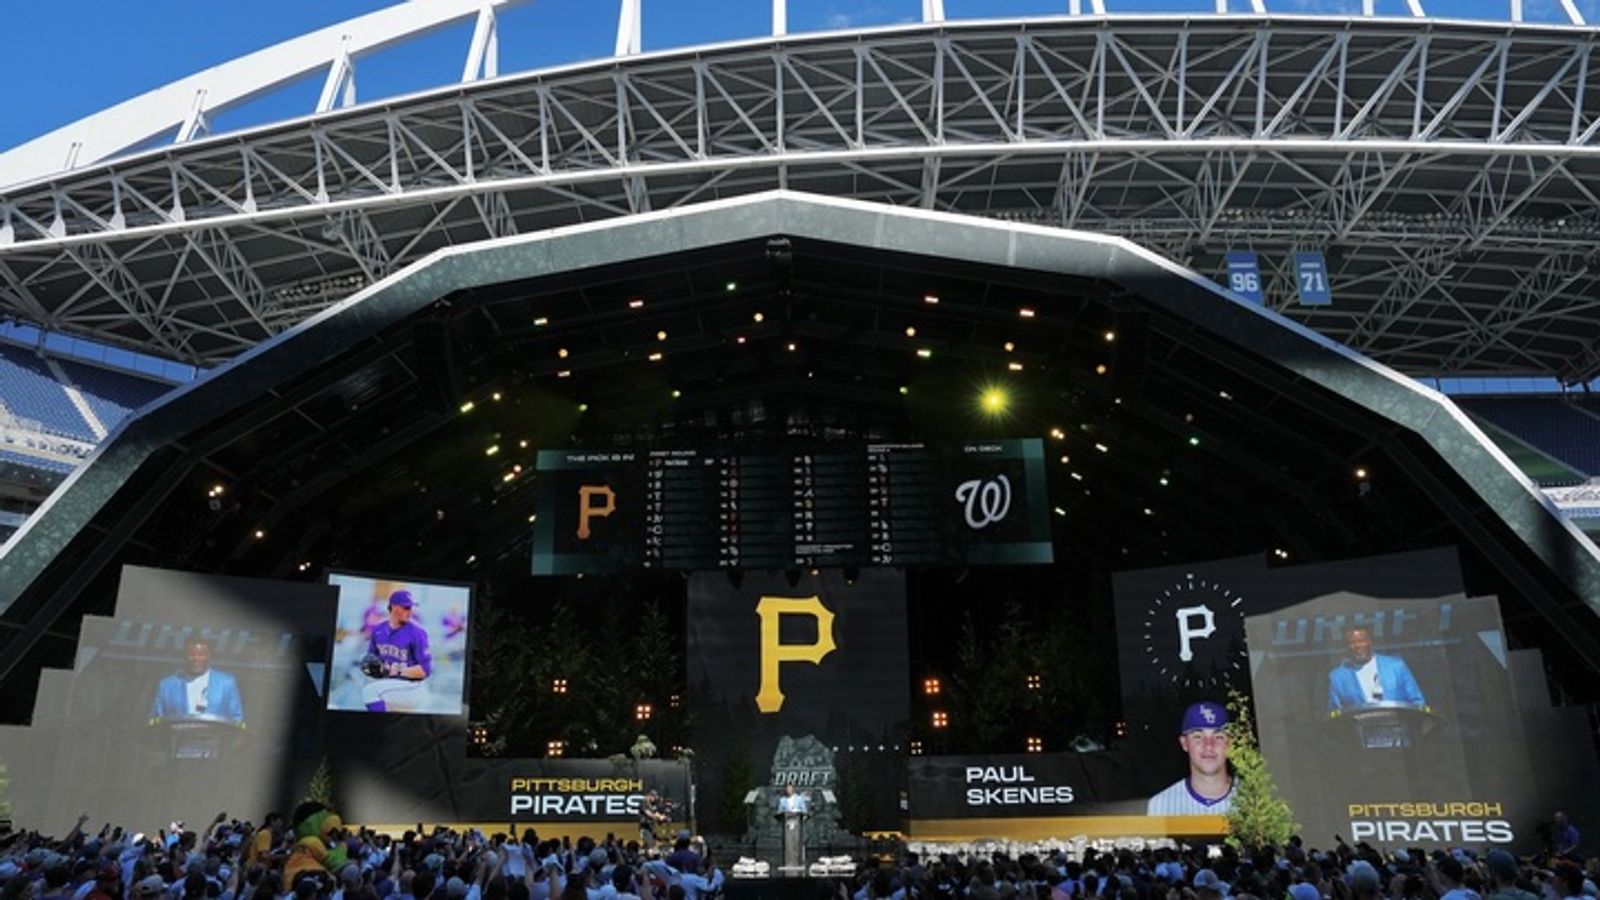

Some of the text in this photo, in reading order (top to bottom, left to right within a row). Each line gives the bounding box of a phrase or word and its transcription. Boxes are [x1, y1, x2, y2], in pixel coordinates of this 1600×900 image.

[1231, 272, 1259, 293] 96
[1301, 273, 1325, 292] 71
[955, 473, 1011, 529] W
[577, 484, 616, 539] P
[1176, 604, 1217, 662] P
[755, 596, 837, 713] P
[774, 770, 832, 786] DRAFT
[966, 765, 1035, 784] PAUL
[511, 778, 643, 792] PITTSBURGH
[510, 795, 645, 815] PIRATES
[966, 786, 1074, 806] SKENES
[1348, 802, 1501, 818] PITTSBURGH
[1350, 820, 1514, 843] PIRATES
